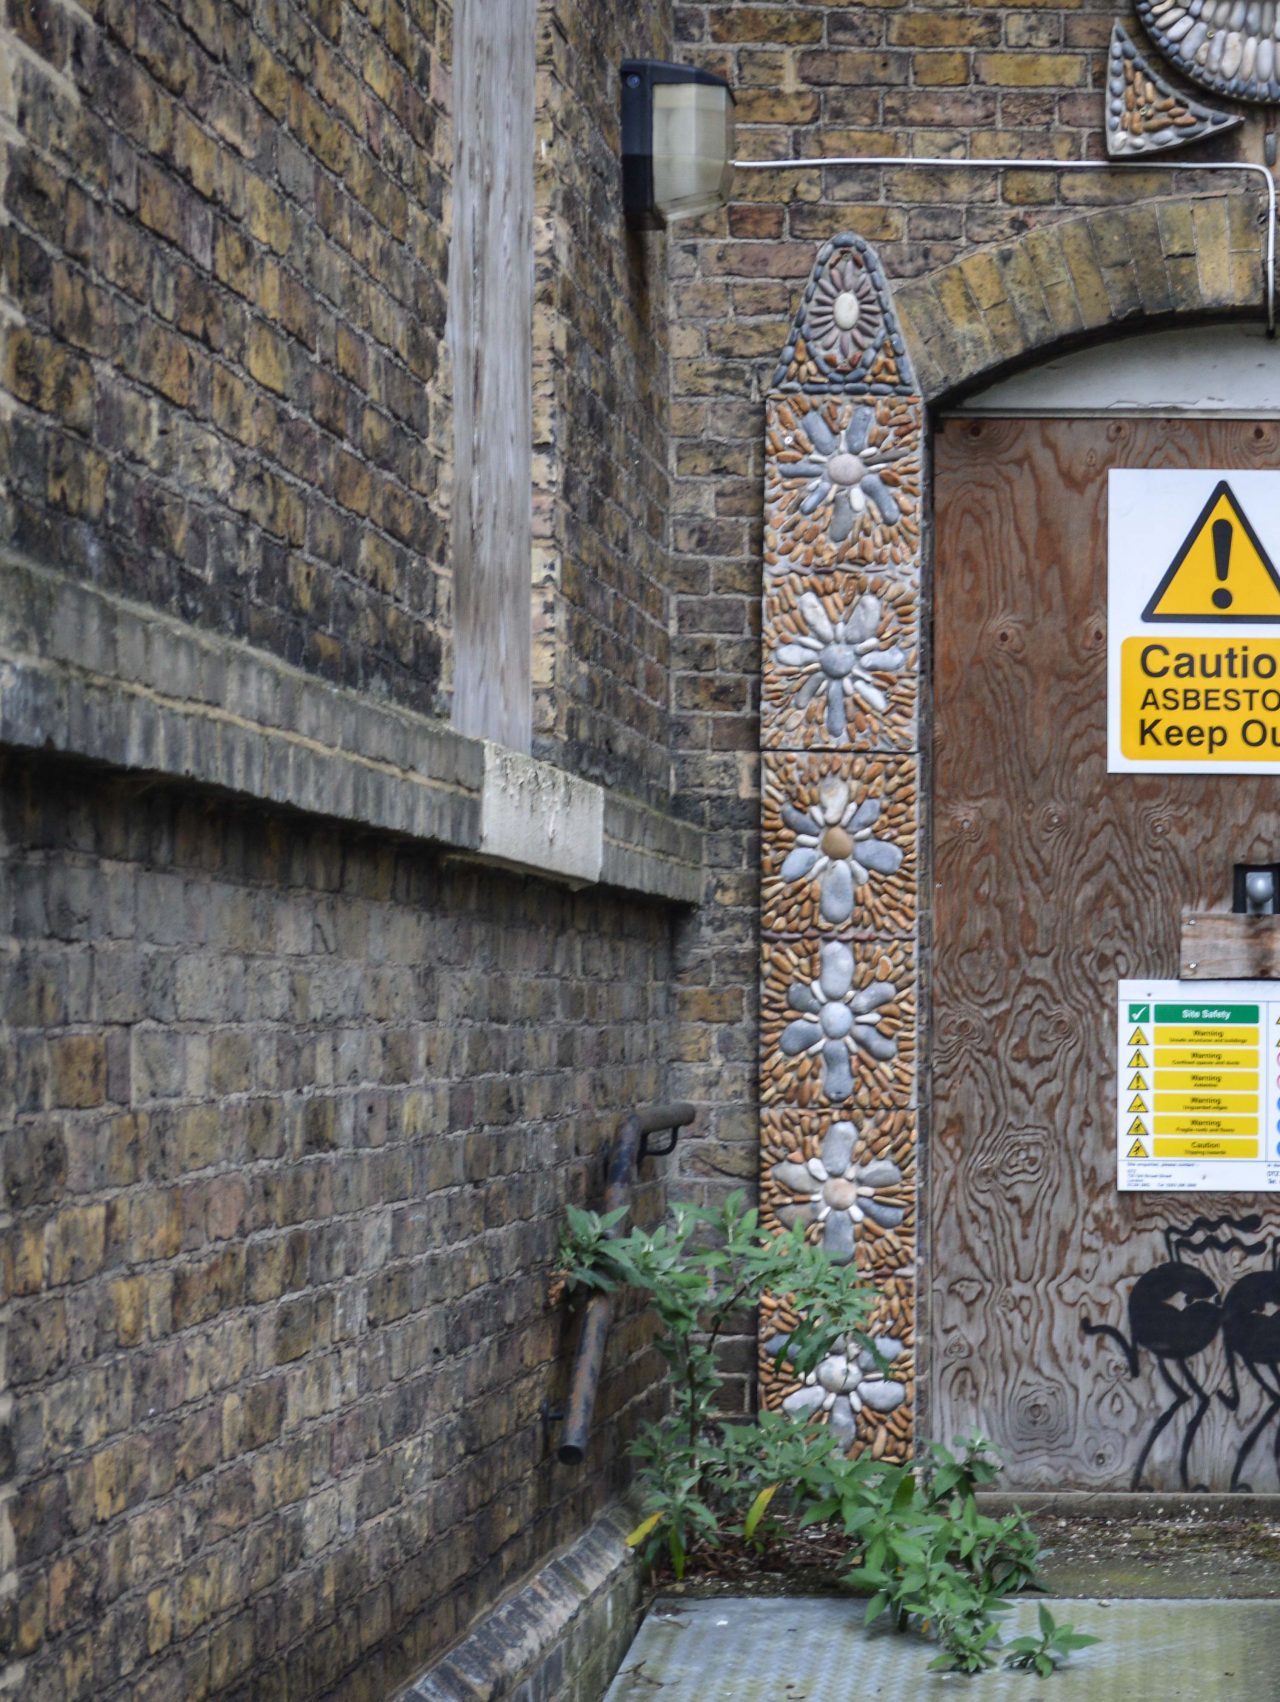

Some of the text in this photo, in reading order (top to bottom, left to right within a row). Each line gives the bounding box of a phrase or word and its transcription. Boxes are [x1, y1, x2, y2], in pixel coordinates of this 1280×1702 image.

[1139, 718, 1228, 754] Keep
[1182, 1009, 1232, 1020] Site Safety
[1193, 1030, 1224, 1038] Warning
[1191, 1052, 1222, 1060] Warning
[1190, 1120, 1222, 1128] Warning
